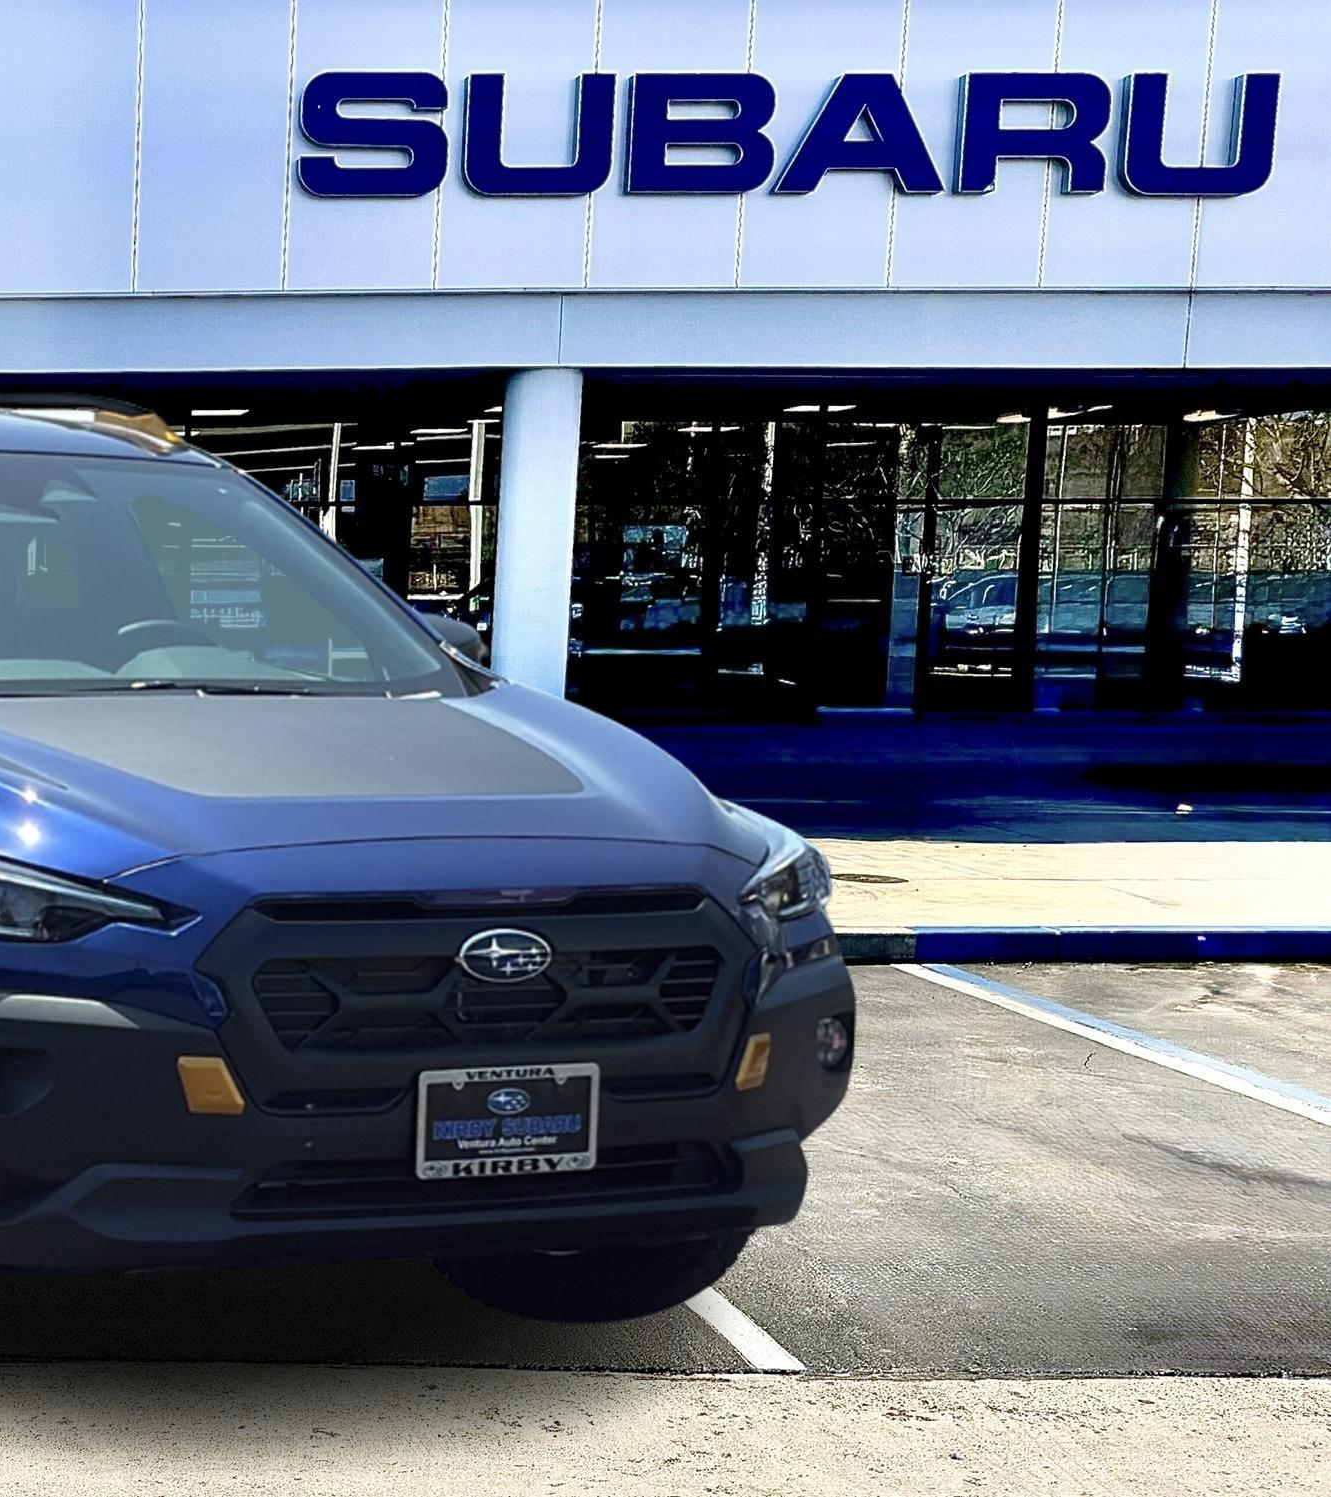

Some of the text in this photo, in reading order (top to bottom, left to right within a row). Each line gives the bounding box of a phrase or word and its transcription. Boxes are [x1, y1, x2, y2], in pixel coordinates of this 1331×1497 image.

[297, 70, 1282, 199] SUBARU
[466, 1067, 555, 1080] VENTURA
[434, 1115, 581, 1139] KIRBY SUBARU
[457, 1135, 558, 1150] Ventura Auto Center
[452, 1157, 564, 1176] KIRBY
